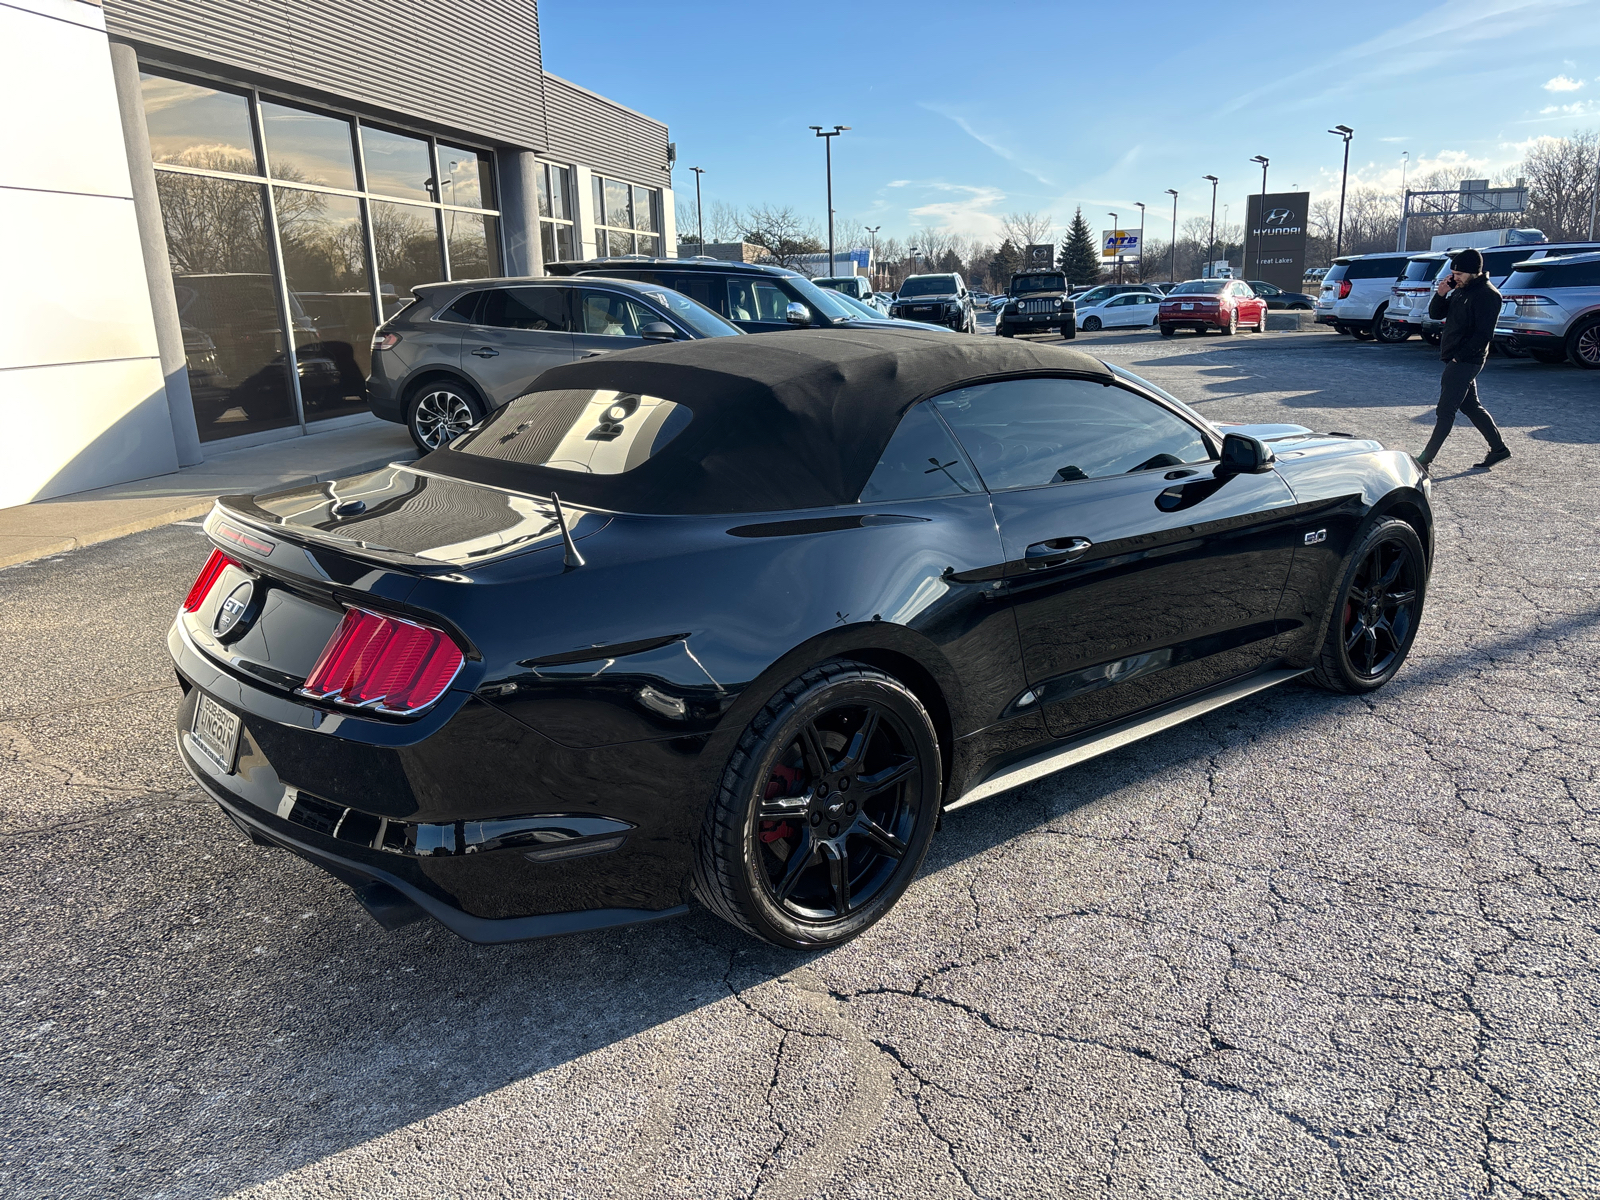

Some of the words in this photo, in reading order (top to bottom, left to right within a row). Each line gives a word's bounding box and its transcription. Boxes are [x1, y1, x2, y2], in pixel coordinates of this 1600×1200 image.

[1253, 227, 1301, 236] HYUNDAI
[223, 596, 246, 615] GT
[201, 709, 233, 750] LINCOLN
